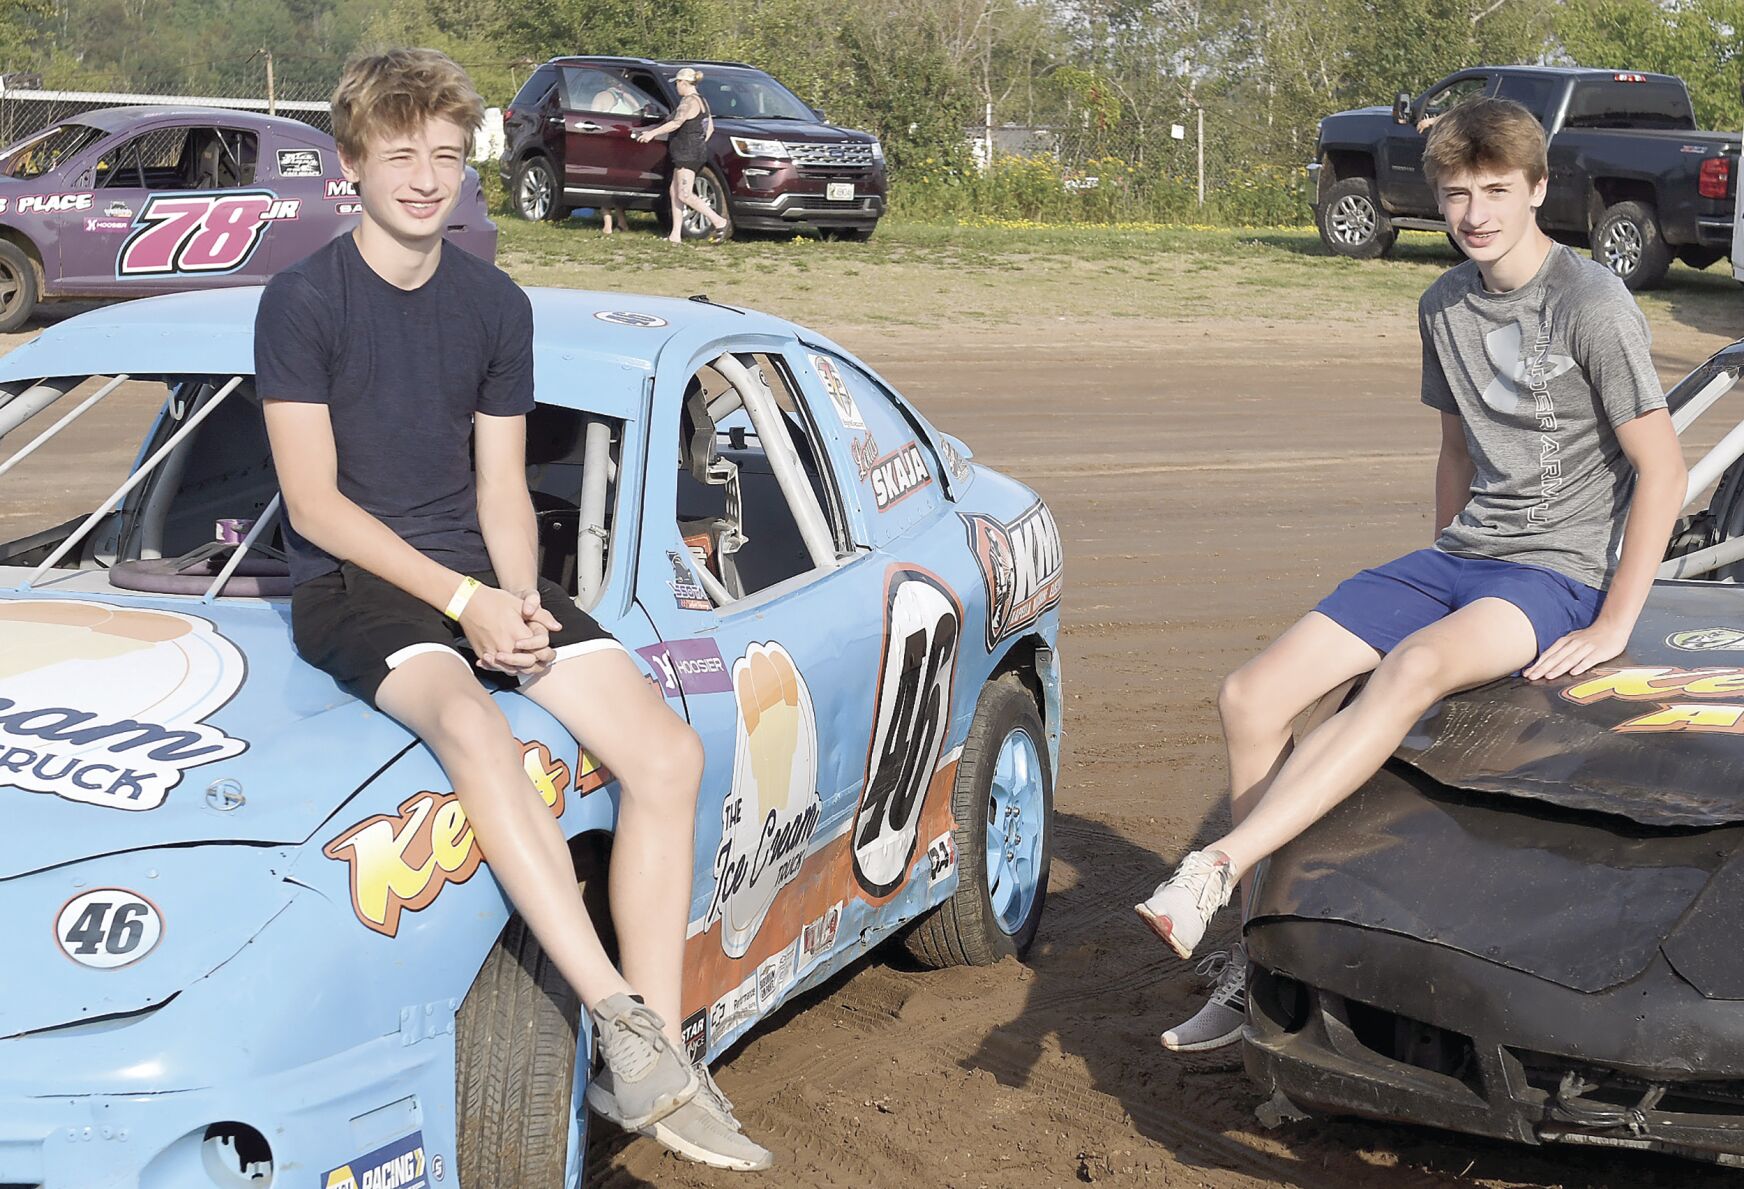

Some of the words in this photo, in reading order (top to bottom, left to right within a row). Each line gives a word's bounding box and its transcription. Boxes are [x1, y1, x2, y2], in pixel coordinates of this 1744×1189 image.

[18, 193, 93, 213] PLACE
[122, 195, 273, 273] 78
[259, 199, 300, 220] JR
[871, 446, 930, 507] SKAJA
[675, 657, 725, 675] HOOSIER
[0, 698, 223, 761] am
[857, 612, 956, 851] 46
[0, 744, 159, 801] RUCK
[725, 797, 742, 831] THE
[708, 837, 749, 923] Ice
[749, 808, 820, 889] Cream
[775, 848, 806, 888] TRUCK
[65, 902, 149, 955] 46
[362, 1150, 415, 1189] RACING
